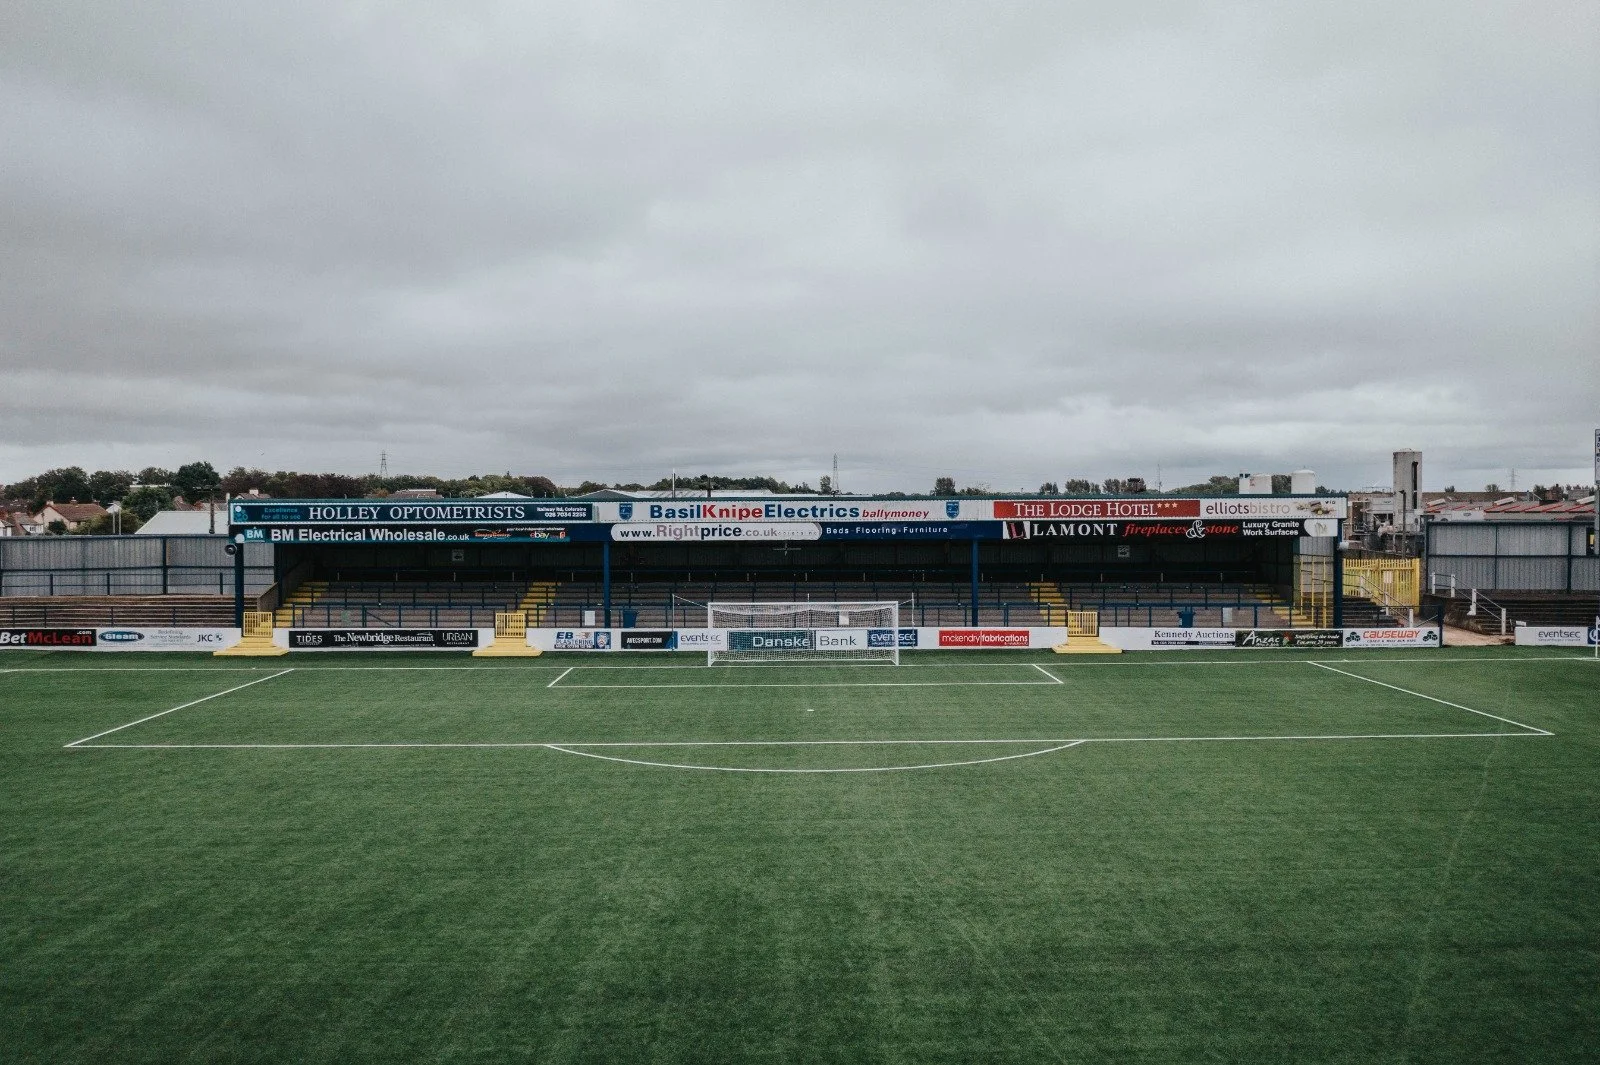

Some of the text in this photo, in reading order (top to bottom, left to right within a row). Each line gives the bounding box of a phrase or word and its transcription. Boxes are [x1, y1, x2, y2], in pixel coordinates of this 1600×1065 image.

[308, 506, 525, 520] HOLLEY OPTOMETRISTS
[1014, 503, 1158, 516] THE LODGE HOTEL
[1206, 502, 1290, 515] elliotsbistro
[862, 509, 929, 520] ballymoney
[1033, 520, 1238, 538] LAMONT fireplaces & stone
[1242, 521, 1268, 529] Luxury
[246, 529, 264, 538] BM
[271, 530, 294, 541] BM
[299, 528, 366, 541] Electrical
[370, 528, 470, 541] Wholesale.co.uk
[530, 531, 550, 539] ebay
[620, 524, 778, 540] www.Rightprice.co.uk
[856, 527, 896, 535] Flooring
[197, 634, 212, 642] JKC
[347, 632, 394, 644] Newbridge
[395, 634, 434, 642] Restaurant
[442, 632, 472, 640] URBAN
[981, 634, 1028, 642] fabrications
[1154, 630, 1234, 640] Kennedy Auctions
[1538, 630, 1580, 638] eventsec
[752, 636, 856, 647] Danske Bank
